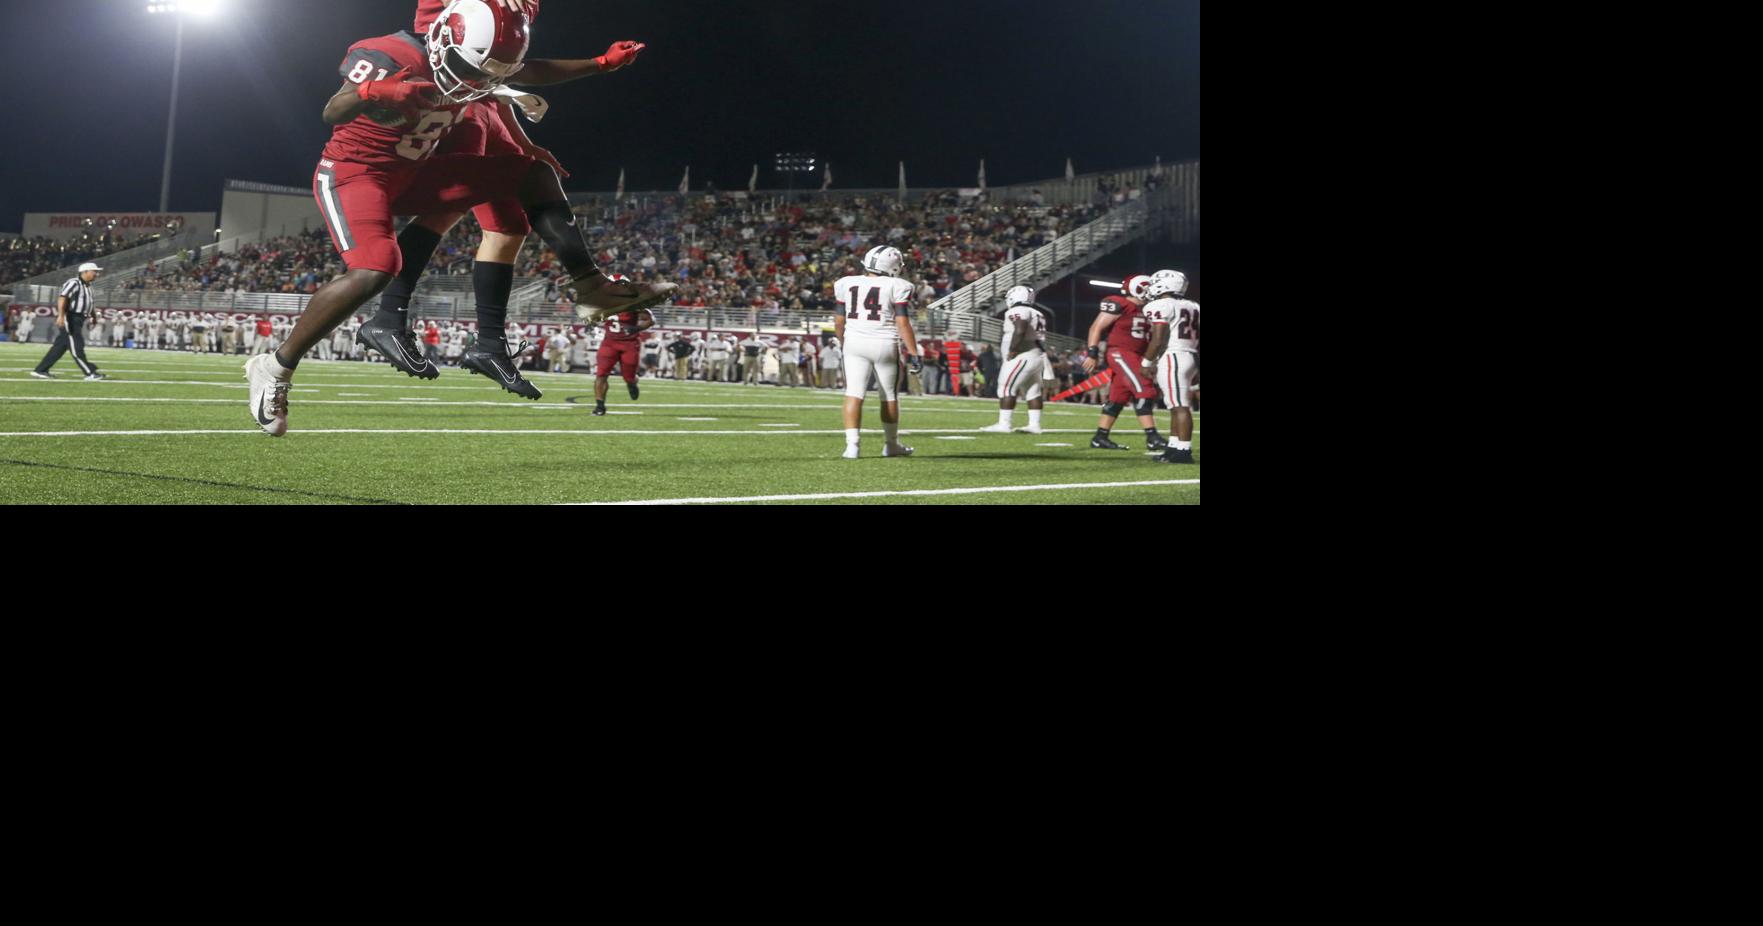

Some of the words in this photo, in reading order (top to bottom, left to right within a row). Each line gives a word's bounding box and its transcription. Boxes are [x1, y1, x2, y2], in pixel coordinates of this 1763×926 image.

[347, 59, 389, 84] 81
[394, 108, 468, 161] 8
[48, 215, 93, 228] PRID
[847, 285, 882, 320] 14
[1100, 302, 1116, 312] 53
[1145, 310, 1163, 321] 24
[1130, 316, 1151, 341] 5
